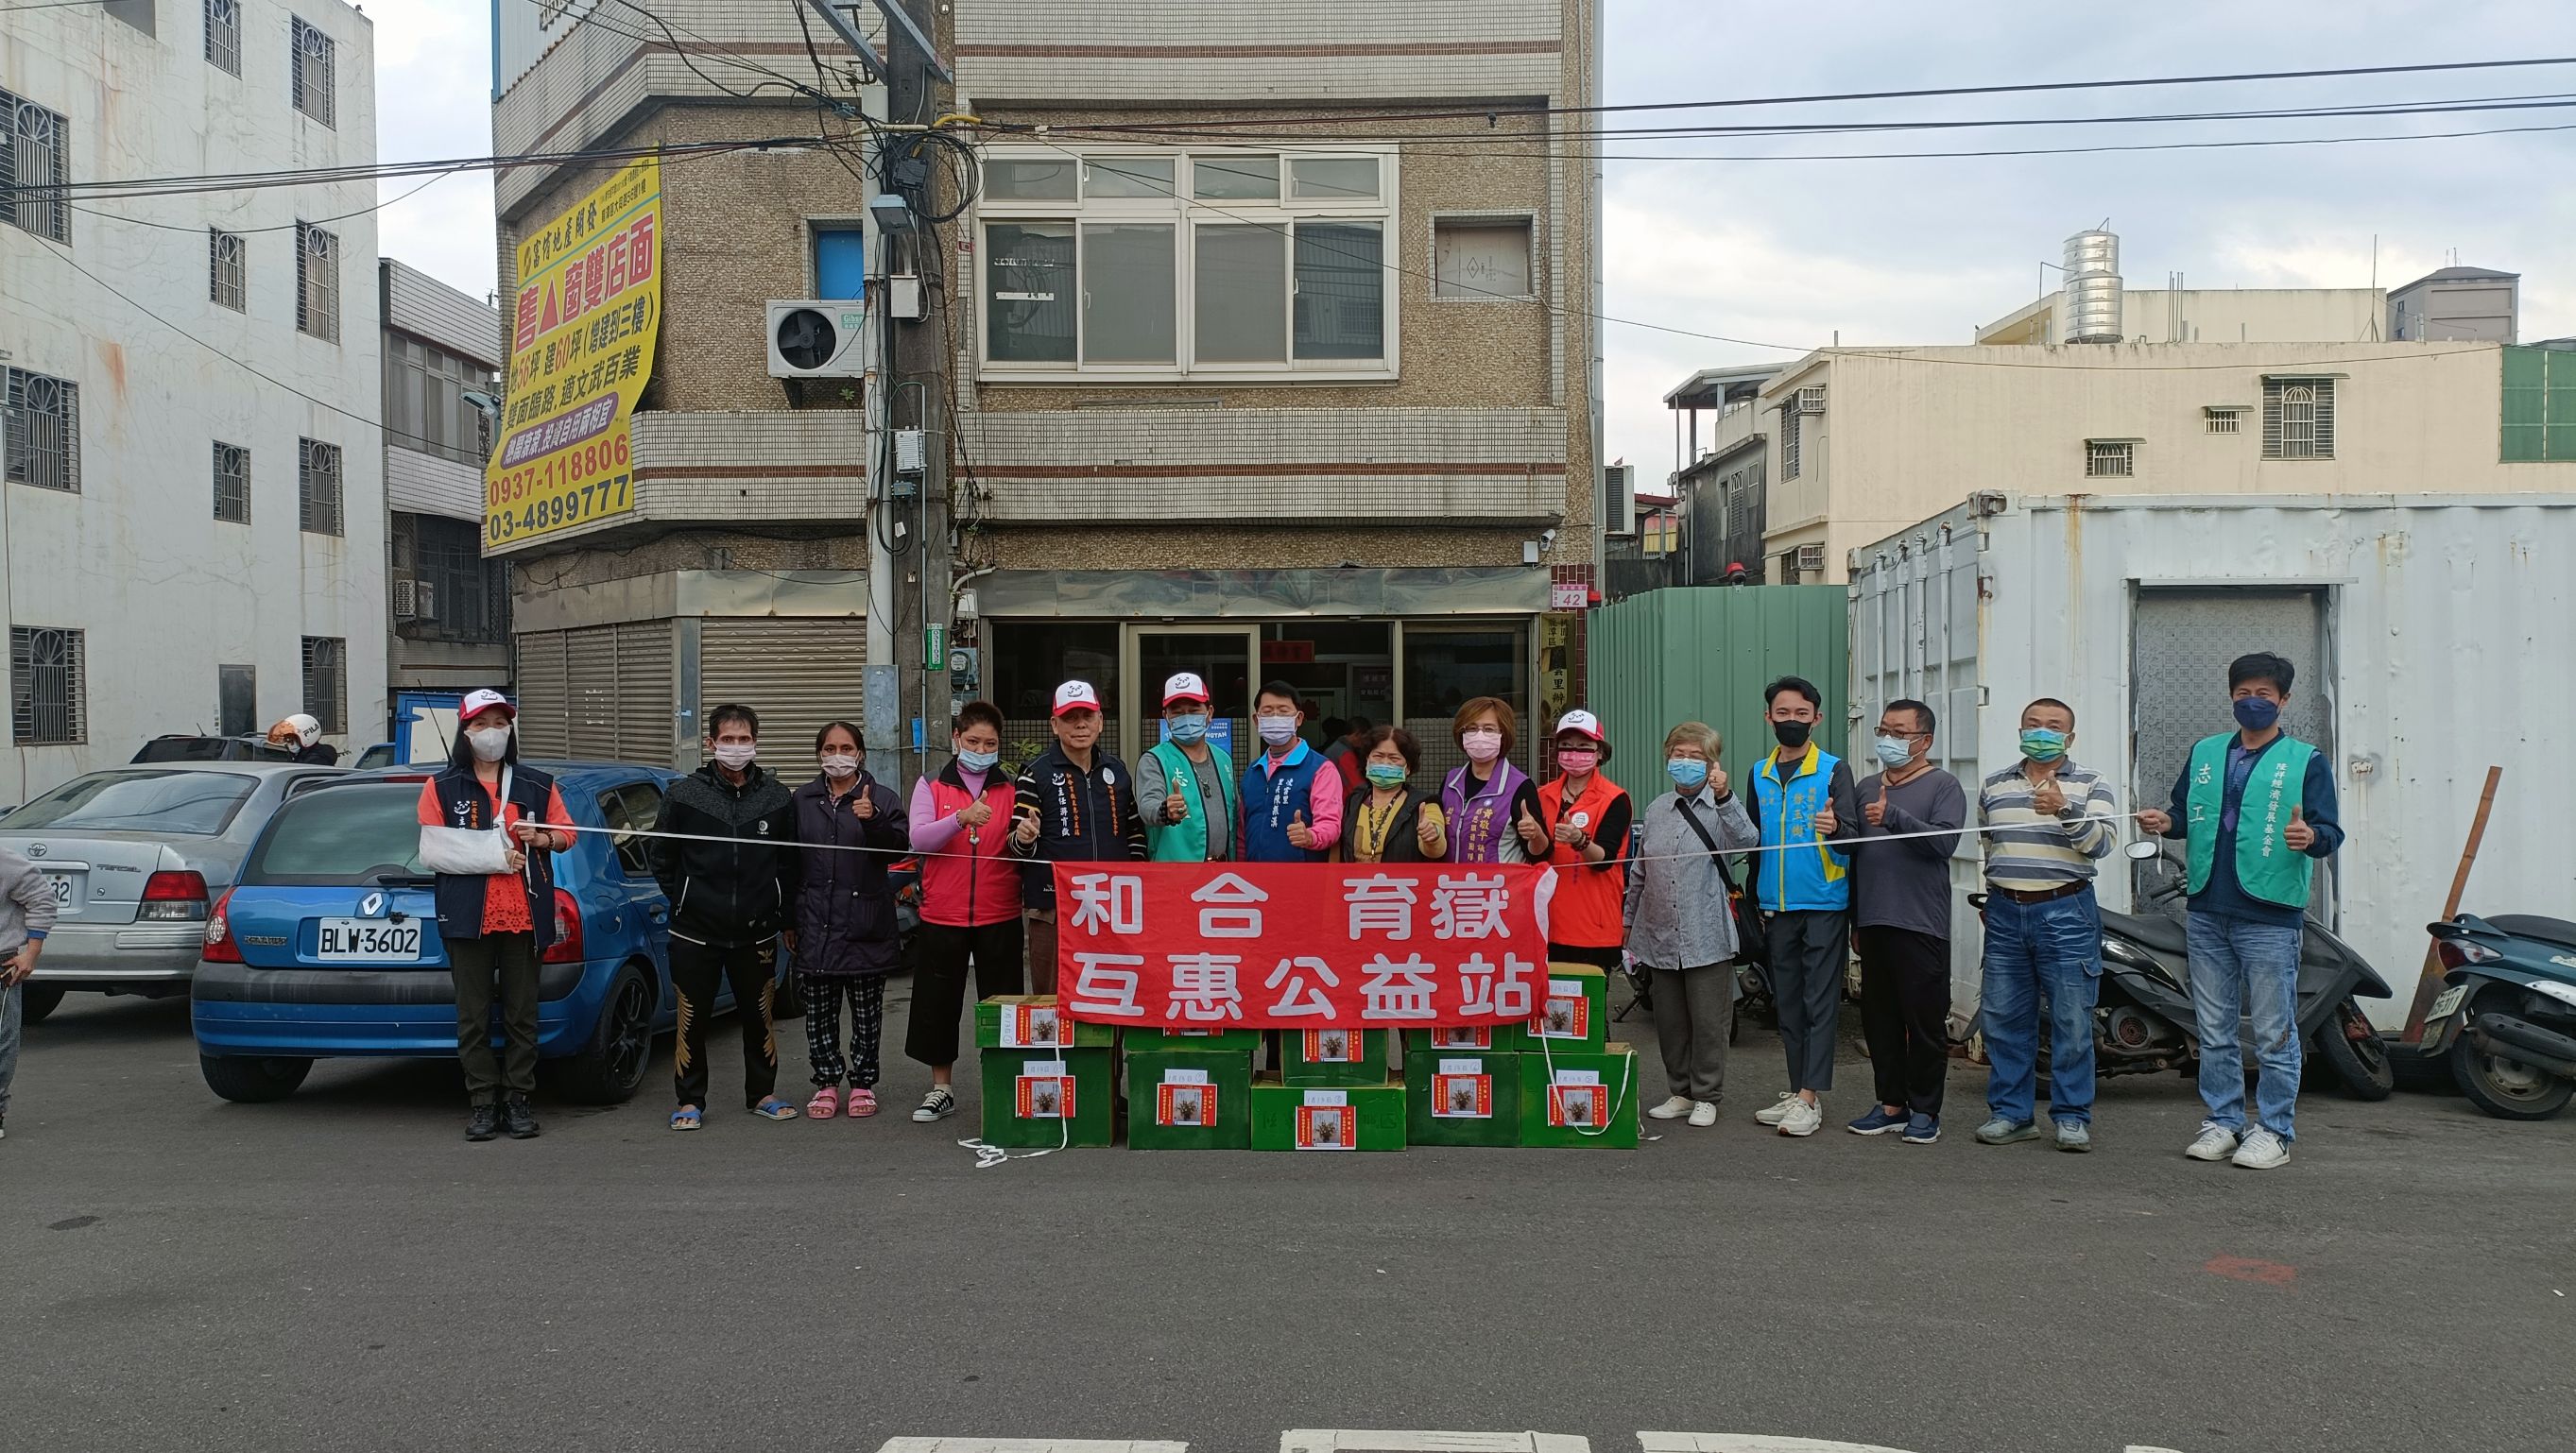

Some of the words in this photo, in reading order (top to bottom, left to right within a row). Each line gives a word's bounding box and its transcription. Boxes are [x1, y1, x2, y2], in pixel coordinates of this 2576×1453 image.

[490, 434, 628, 506] 0937-118806
[490, 474, 628, 540] 03-4899777
[1563, 594, 1581, 606] 42
[302, 723, 319, 737] FILA
[51, 881, 70, 902] 32
[1069, 951, 1534, 1020] 互惠公益站
